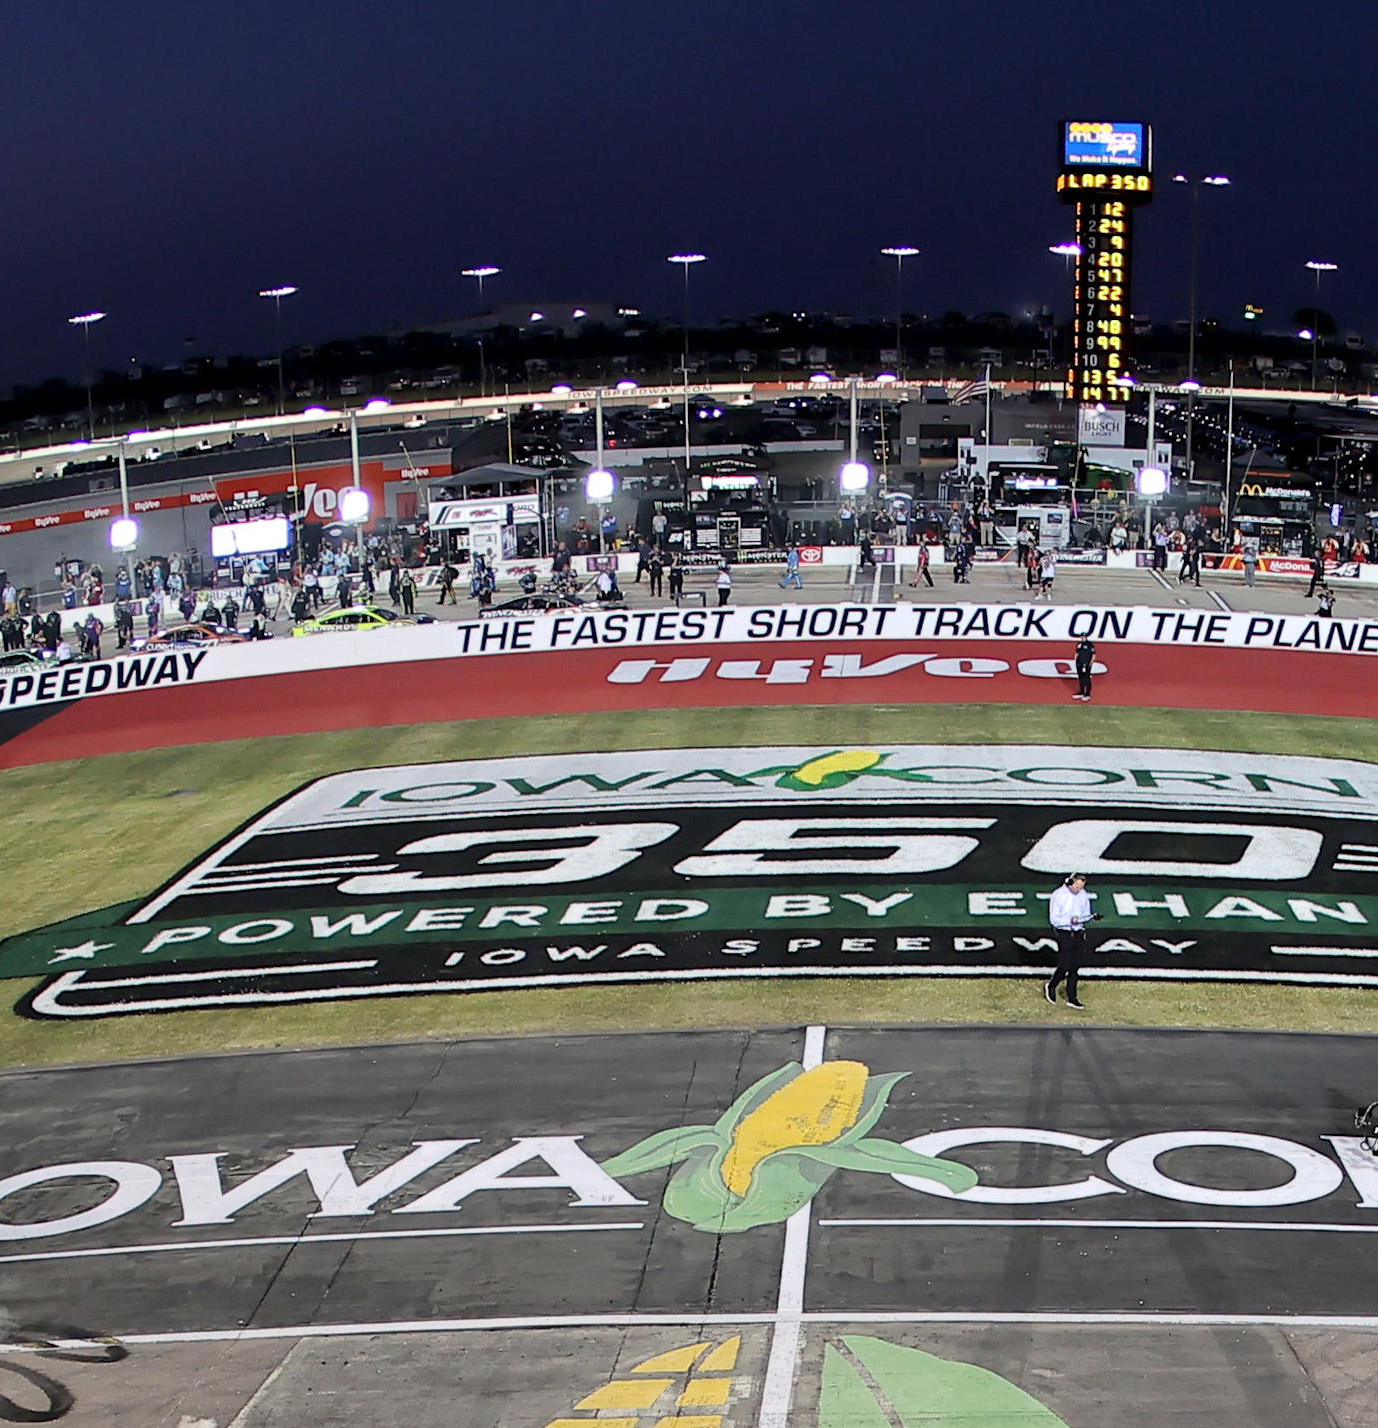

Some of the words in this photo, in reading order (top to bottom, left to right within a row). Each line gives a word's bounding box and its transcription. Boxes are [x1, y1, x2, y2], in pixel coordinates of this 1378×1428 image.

[1069, 174, 1107, 188] LAP
[1111, 174, 1149, 191] 350
[1090, 203, 1096, 215] 1
[1105, 202, 1123, 217] 12
[1088, 220, 1096, 232] 2
[1099, 218, 1123, 233] 24
[1088, 237, 1096, 248] 3
[1111, 235, 1123, 249] 9
[1088, 253, 1095, 265] 4
[1098, 251, 1123, 267] 20
[1088, 270, 1095, 282] 5
[1098, 268, 1123, 282] 47
[1088, 287, 1095, 299] 6
[1098, 285, 1122, 301] 22
[1087, 304, 1094, 316] 7
[1110, 303, 1122, 316] 4
[1087, 320, 1094, 333] 8
[1097, 320, 1121, 335] 48
[1087, 338, 1094, 350] 9
[1097, 336, 1121, 350] 99
[1082, 354, 1098, 367] 10
[1108, 353, 1121, 368] 6
[1083, 369, 1102, 385] 13
[567, 384, 713, 398] IOWSPEEDWAY.COM
[1083, 387, 1102, 400] 14
[1106, 387, 1130, 401] 77
[1084, 421, 1119, 432] BUSCH
[457, 621, 541, 654] THE
[550, 610, 735, 649] FASTEST
[746, 607, 904, 639] SHORT
[910, 607, 1049, 639] TRACK
[1068, 609, 1134, 640] ON
[1151, 611, 1225, 645] THE
[605, 653, 1109, 684] HyVee
[343, 768, 759, 809] IOWA
[913, 766, 1363, 798] CORN
[336, 817, 1325, 895] 350
[142, 896, 710, 954] POWERED
[764, 889, 913, 920] BY
[443, 941, 667, 967] IOWA
[720, 937, 1200, 956] SPEEDWAY
